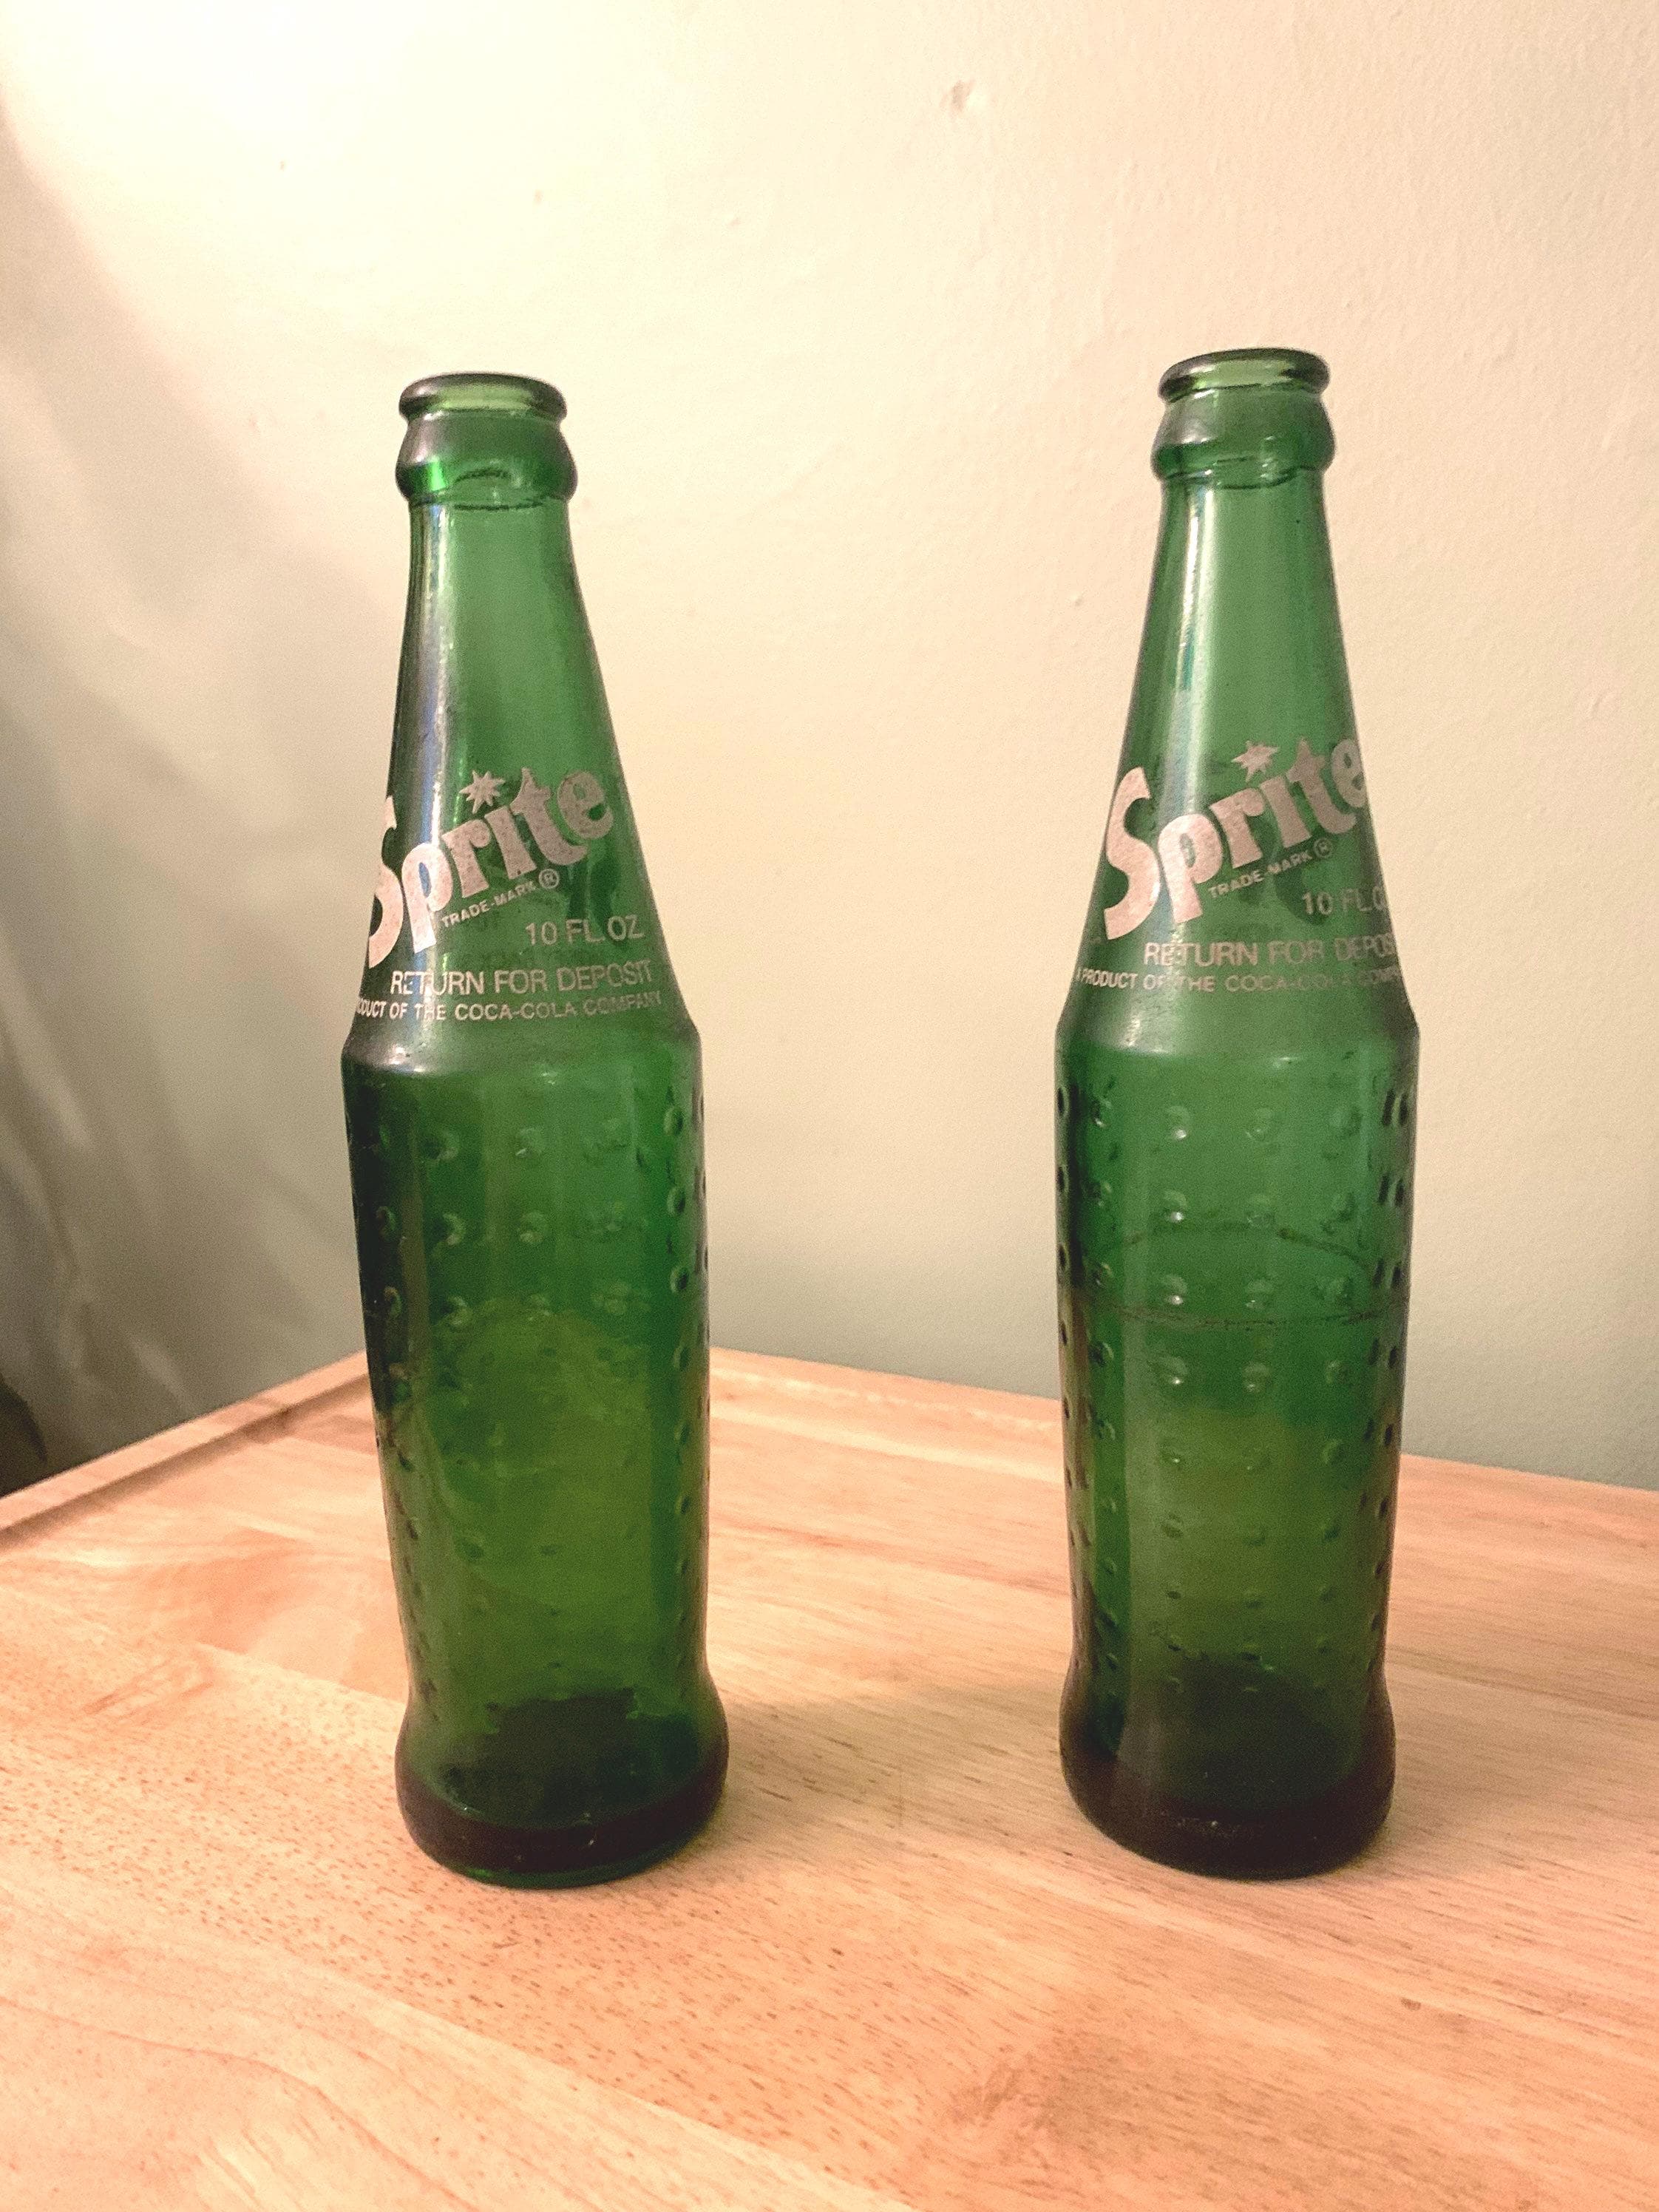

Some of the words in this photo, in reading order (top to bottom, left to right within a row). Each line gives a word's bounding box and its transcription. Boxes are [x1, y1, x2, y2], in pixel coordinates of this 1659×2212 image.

[1104, 737, 1368, 940] Sprite
[1302, 890, 1332, 916] 10
[1341, 888, 1373, 913] FL
[525, 921, 557, 946] 10
[565, 918, 605, 944] FL
[607, 914, 646, 942] OZ
[1144, 941, 1258, 966] RETURN
[1266, 940, 1325, 964] FOR
[390, 969, 485, 996] RETURN
[494, 968, 549, 994] FOR
[556, 958, 652, 991] DEPOSIT
[1081, 967, 1138, 989] PRODUCT
[1142, 973, 1167, 991] OF
[389, 1002, 408, 1020] OF
[414, 1002, 447, 1021] THE
[454, 1001, 579, 1021] COCA-COLA
